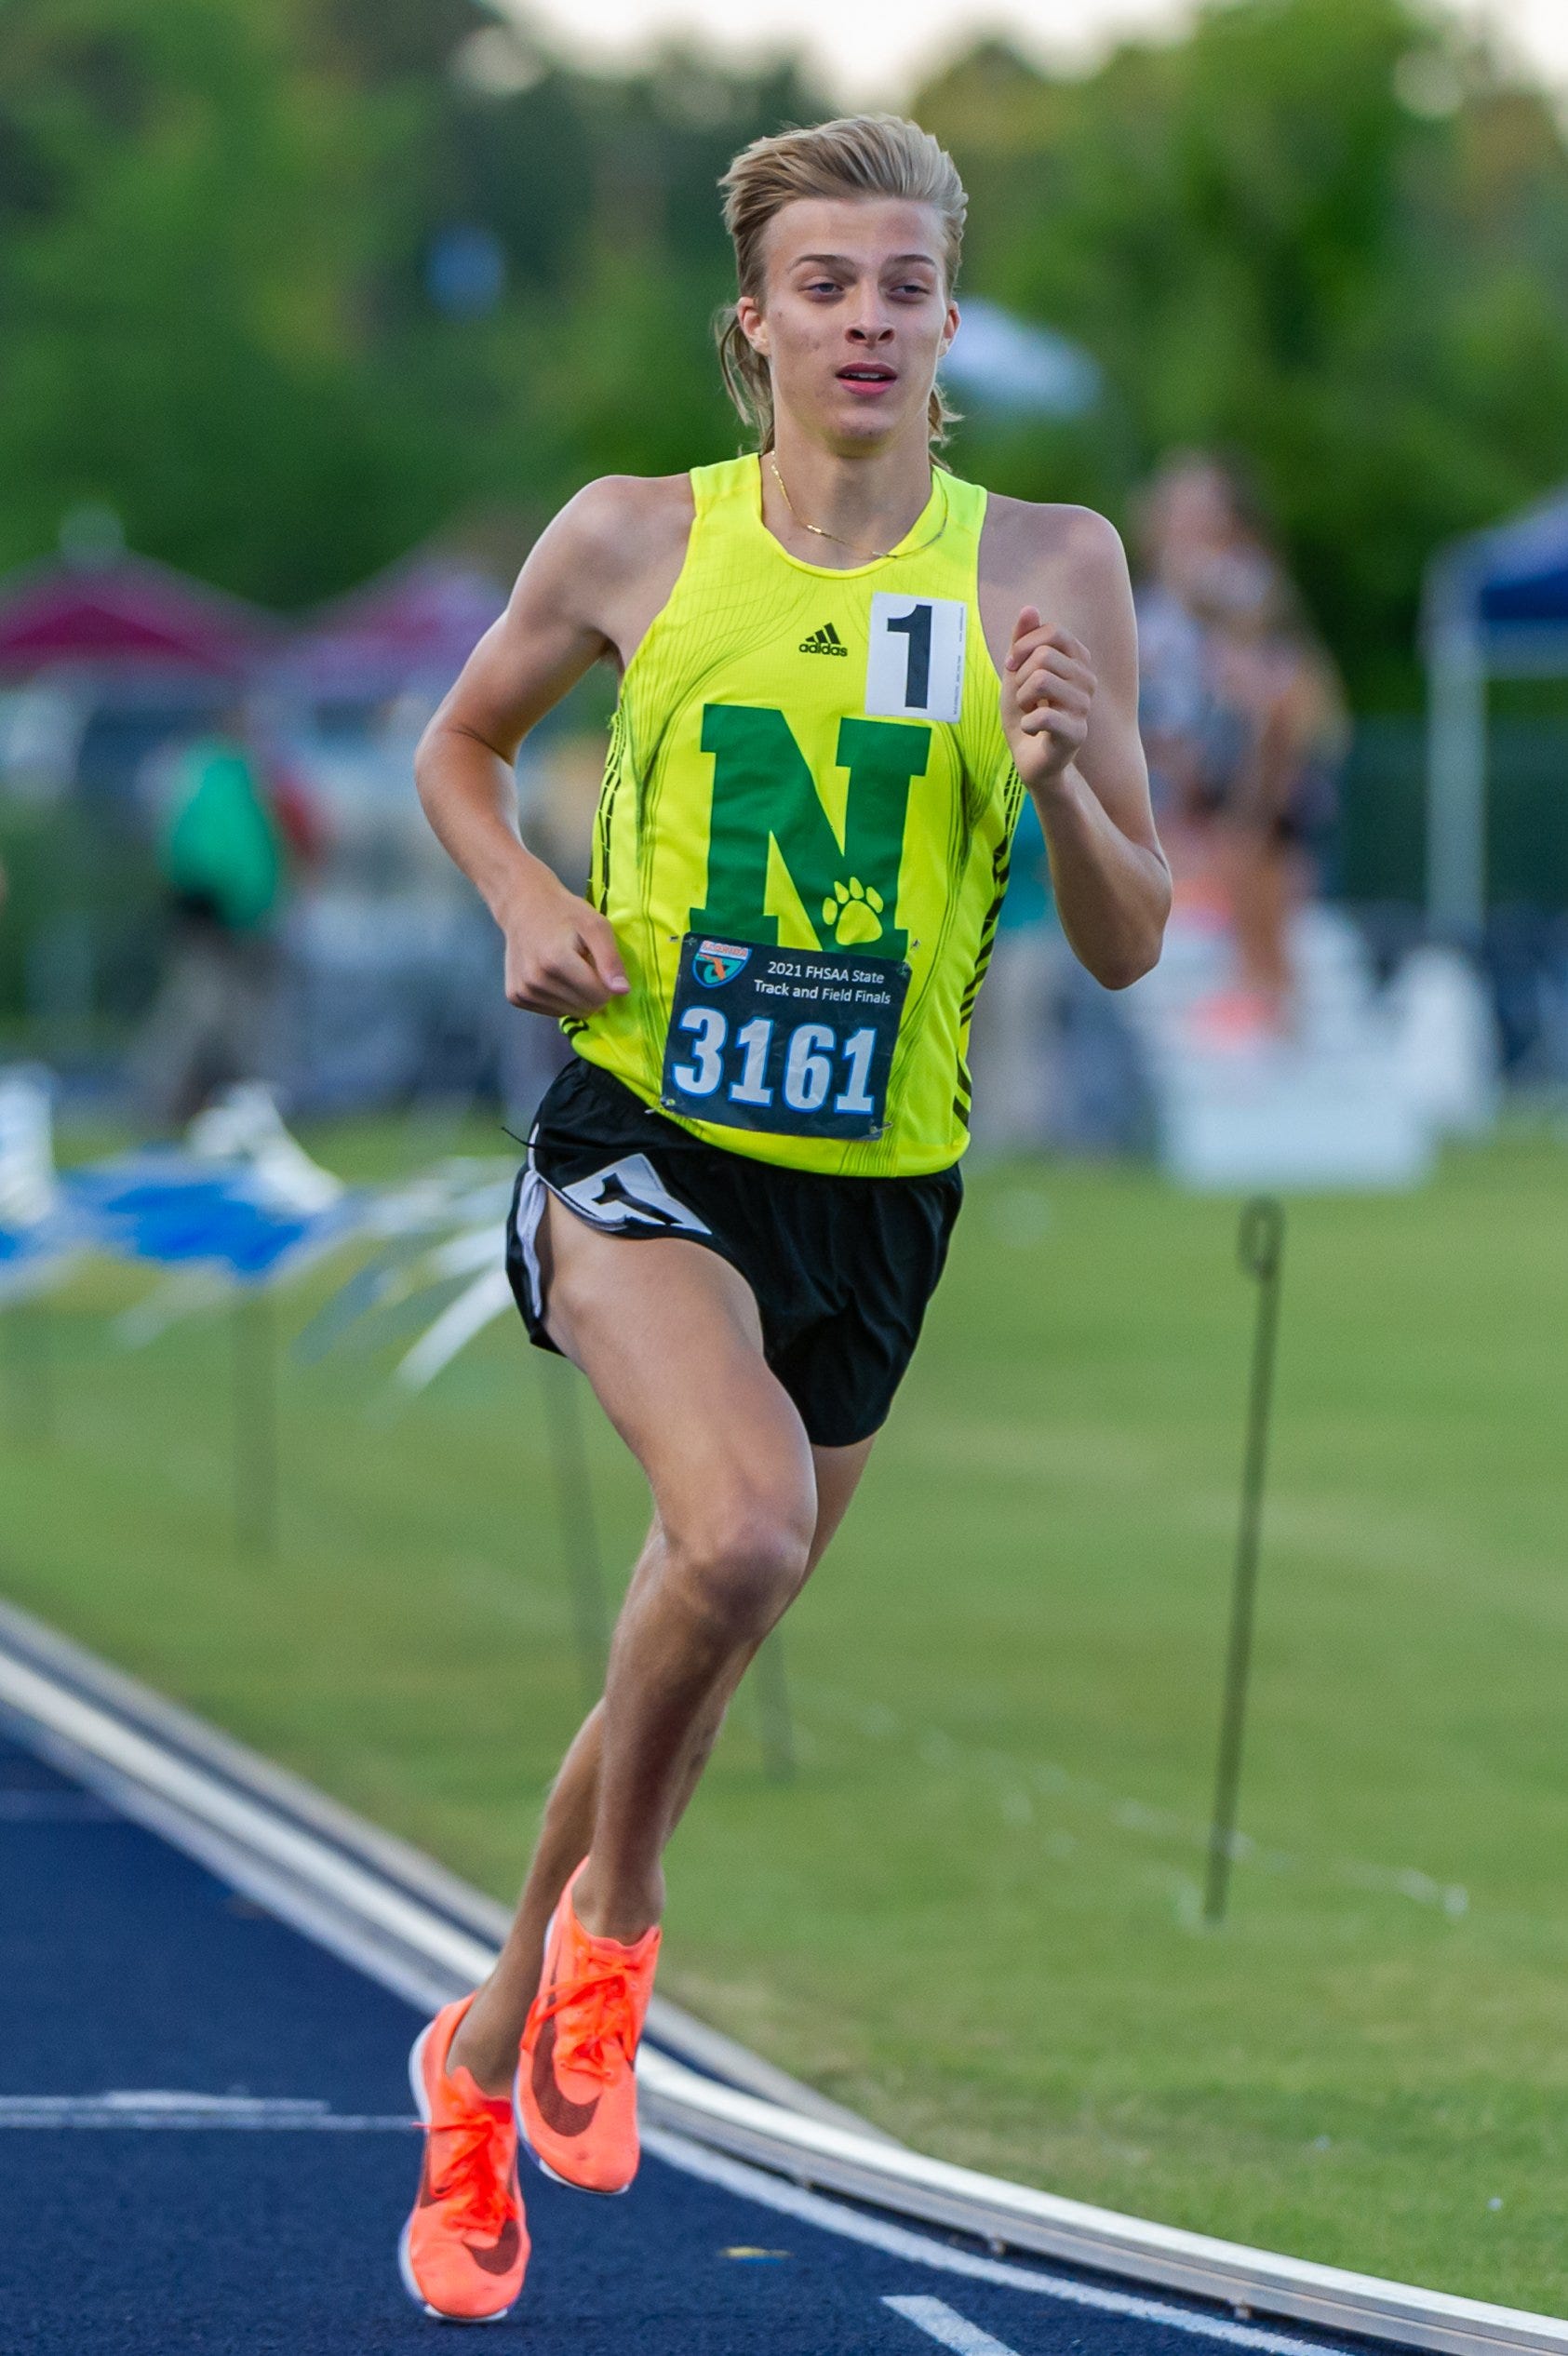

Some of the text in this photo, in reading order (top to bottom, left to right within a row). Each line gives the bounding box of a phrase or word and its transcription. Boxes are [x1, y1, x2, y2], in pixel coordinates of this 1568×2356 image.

[798, 642, 848, 657] adidas
[887, 604, 932, 709] 1
[689, 703, 932, 957] N
[754, 979, 891, 1005] Track and Field Finals
[767, 961, 885, 984] 2021 FHSAA State
[671, 1006, 878, 1115] 3161
